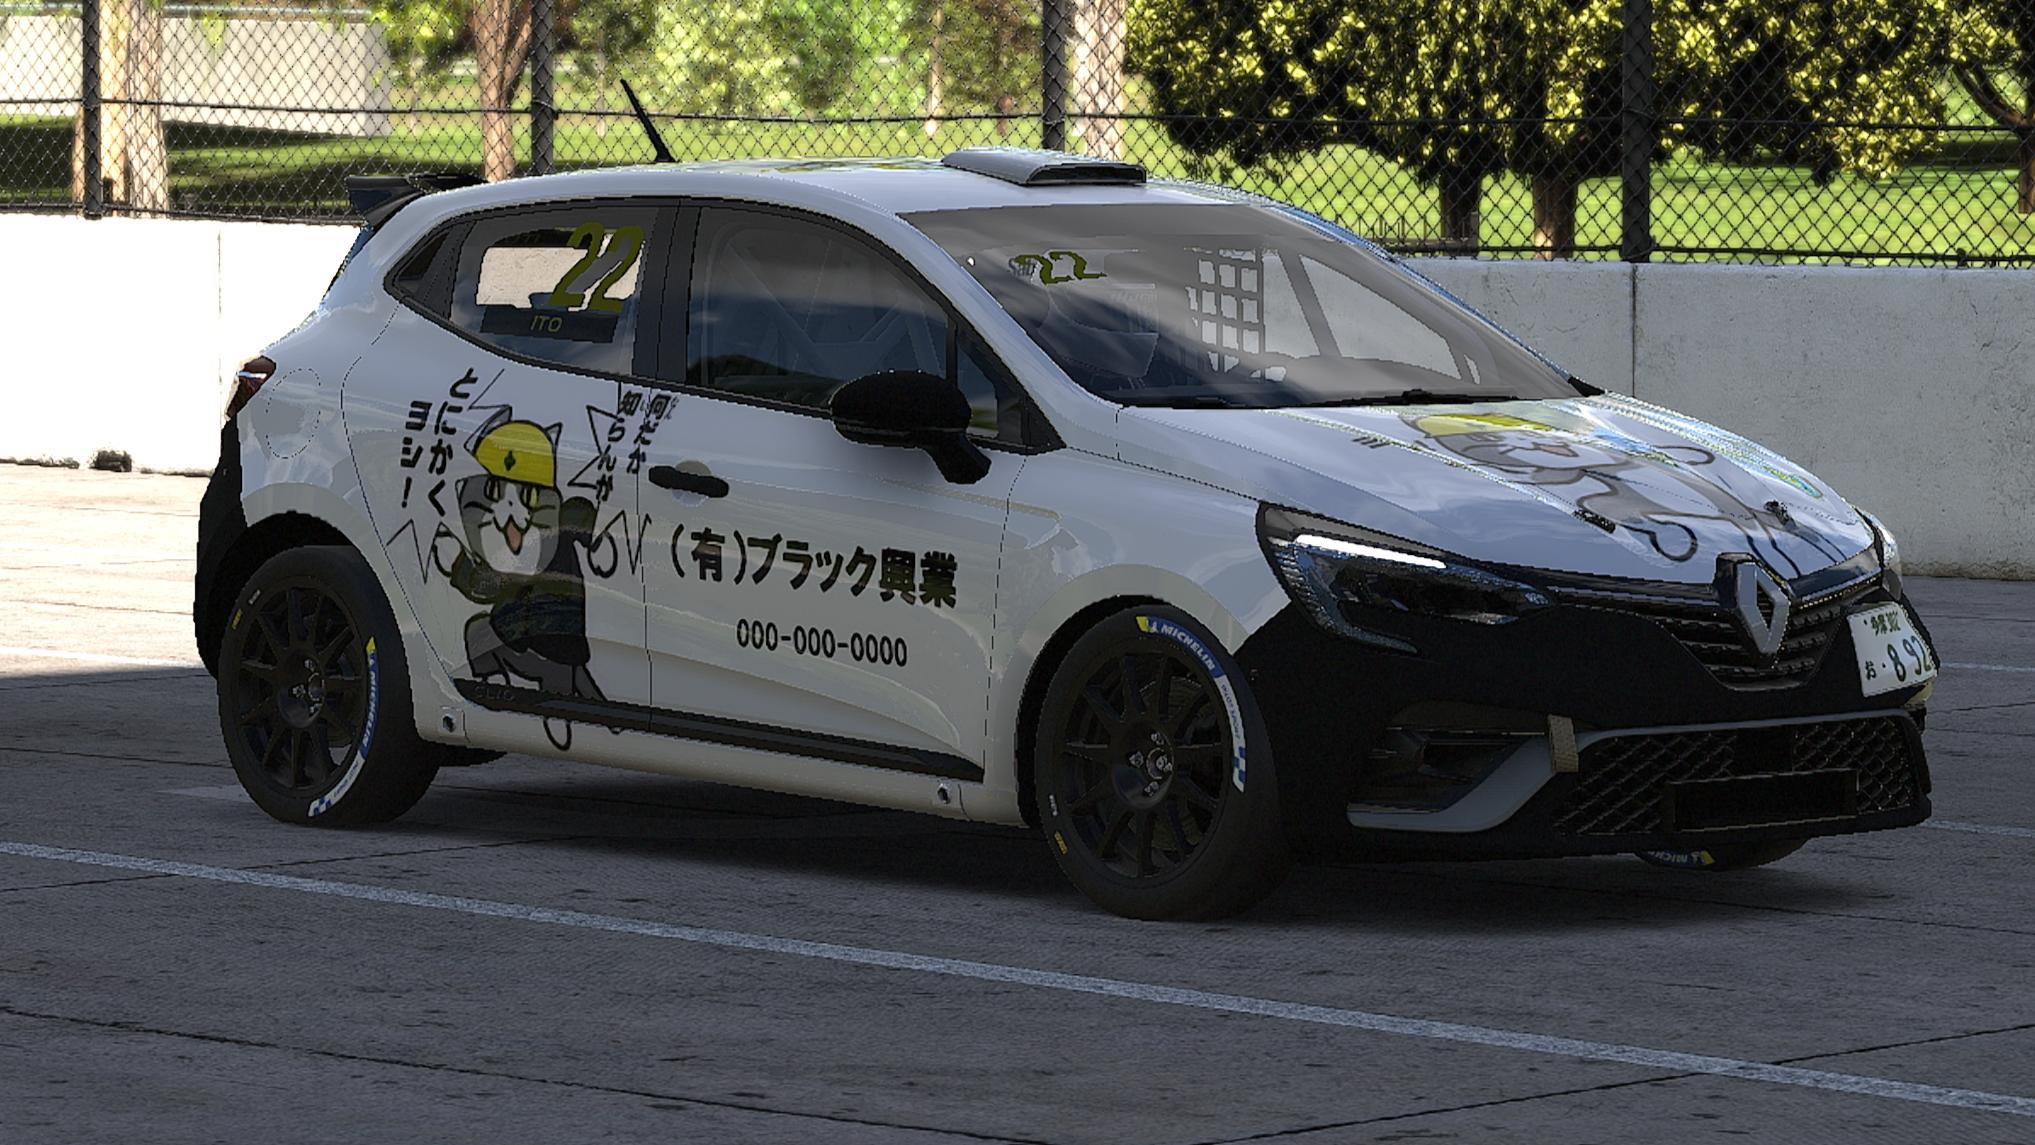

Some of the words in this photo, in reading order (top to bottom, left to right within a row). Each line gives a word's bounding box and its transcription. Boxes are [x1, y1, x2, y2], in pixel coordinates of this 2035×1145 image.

[548, 222, 644, 312] 22
[1014, 251, 1107, 285] 22
[530, 315, 563, 332] ITO
[428, 368, 478, 516] とにかく
[737, 618, 908, 667] 000-000-0000
[1160, 625, 1216, 671] MICHELIN
